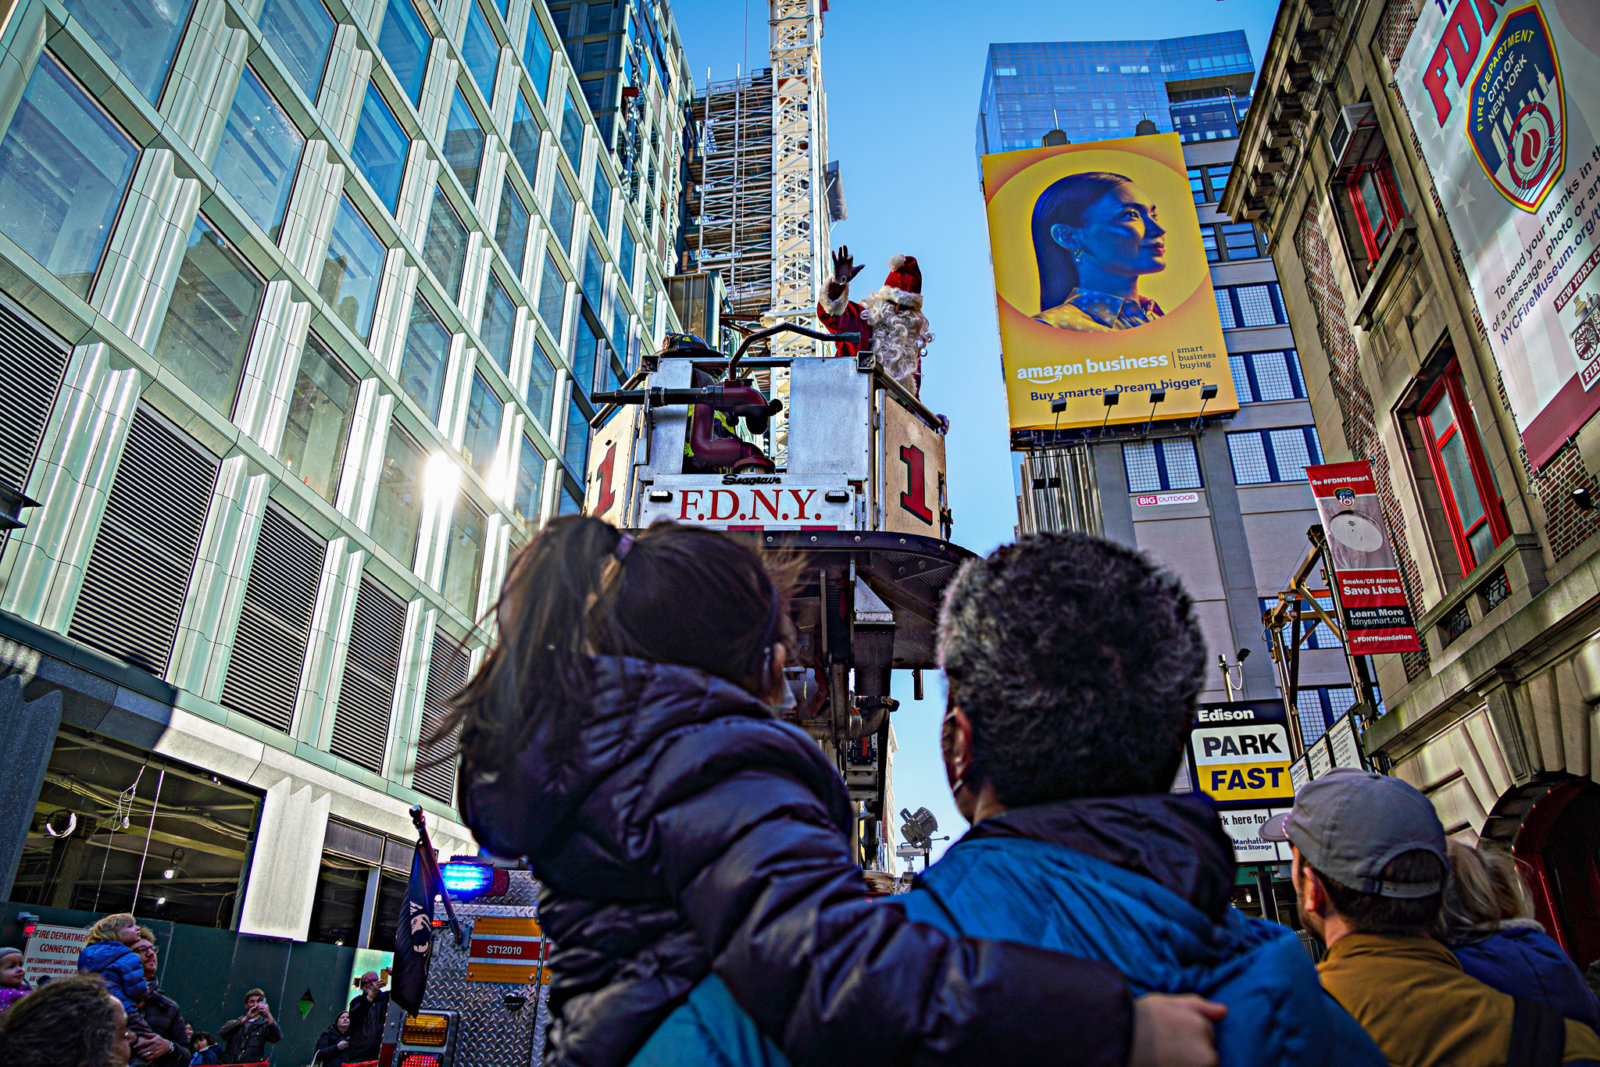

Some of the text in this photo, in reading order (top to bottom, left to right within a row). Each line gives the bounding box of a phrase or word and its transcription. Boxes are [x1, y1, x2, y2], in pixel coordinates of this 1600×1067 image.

[1481, 30, 1535, 92] DEPARTMENT
[1487, 50, 1516, 102] CITY OF
[1487, 54, 1528, 124] NEW YORK
[1494, 284, 1506, 300] To
[1506, 252, 1527, 287] send
[1525, 225, 1546, 260] your
[1546, 178, 1580, 227] thanks
[1578, 161, 1593, 180] in
[1492, 316, 1502, 332] of
[1501, 311, 1508, 320] a
[1506, 258, 1547, 310] message,
[1545, 217, 1573, 260] photo
[1574, 198, 1586, 217] or
[1500, 202, 1600, 345] NYCFireMuseum.org/t
[1555, 246, 1600, 310] NEW YORK C
[1176, 345, 1204, 354] smart
[1178, 352, 1216, 362] business
[1016, 355, 1169, 380] amazon business
[1179, 361, 1212, 370] buying
[1030, 377, 1206, 402] Buy smarter Dream bigger.
[722, 474, 782, 486] Seagrave
[900, 444, 933, 526] 1
[1323, 475, 1370, 484] #FDNYSmart
[676, 488, 822, 521] F.D.N.Y.
[1158, 494, 1196, 502] OUTDOOR
[1343, 585, 1402, 596] Save Lives
[1350, 608, 1404, 618] Learn More
[1351, 616, 1406, 626] fdnysmart.org
[1198, 708, 1255, 723] Edison
[1202, 732, 1283, 758] PARK
[1211, 766, 1285, 792] FAST
[1232, 814, 1252, 825] here
[1254, 814, 1267, 824] for
[34, 930, 88, 942] FIRE DEPARTMEN
[40, 944, 82, 954] CONNECTION
[486, 945, 522, 956] ST12010
